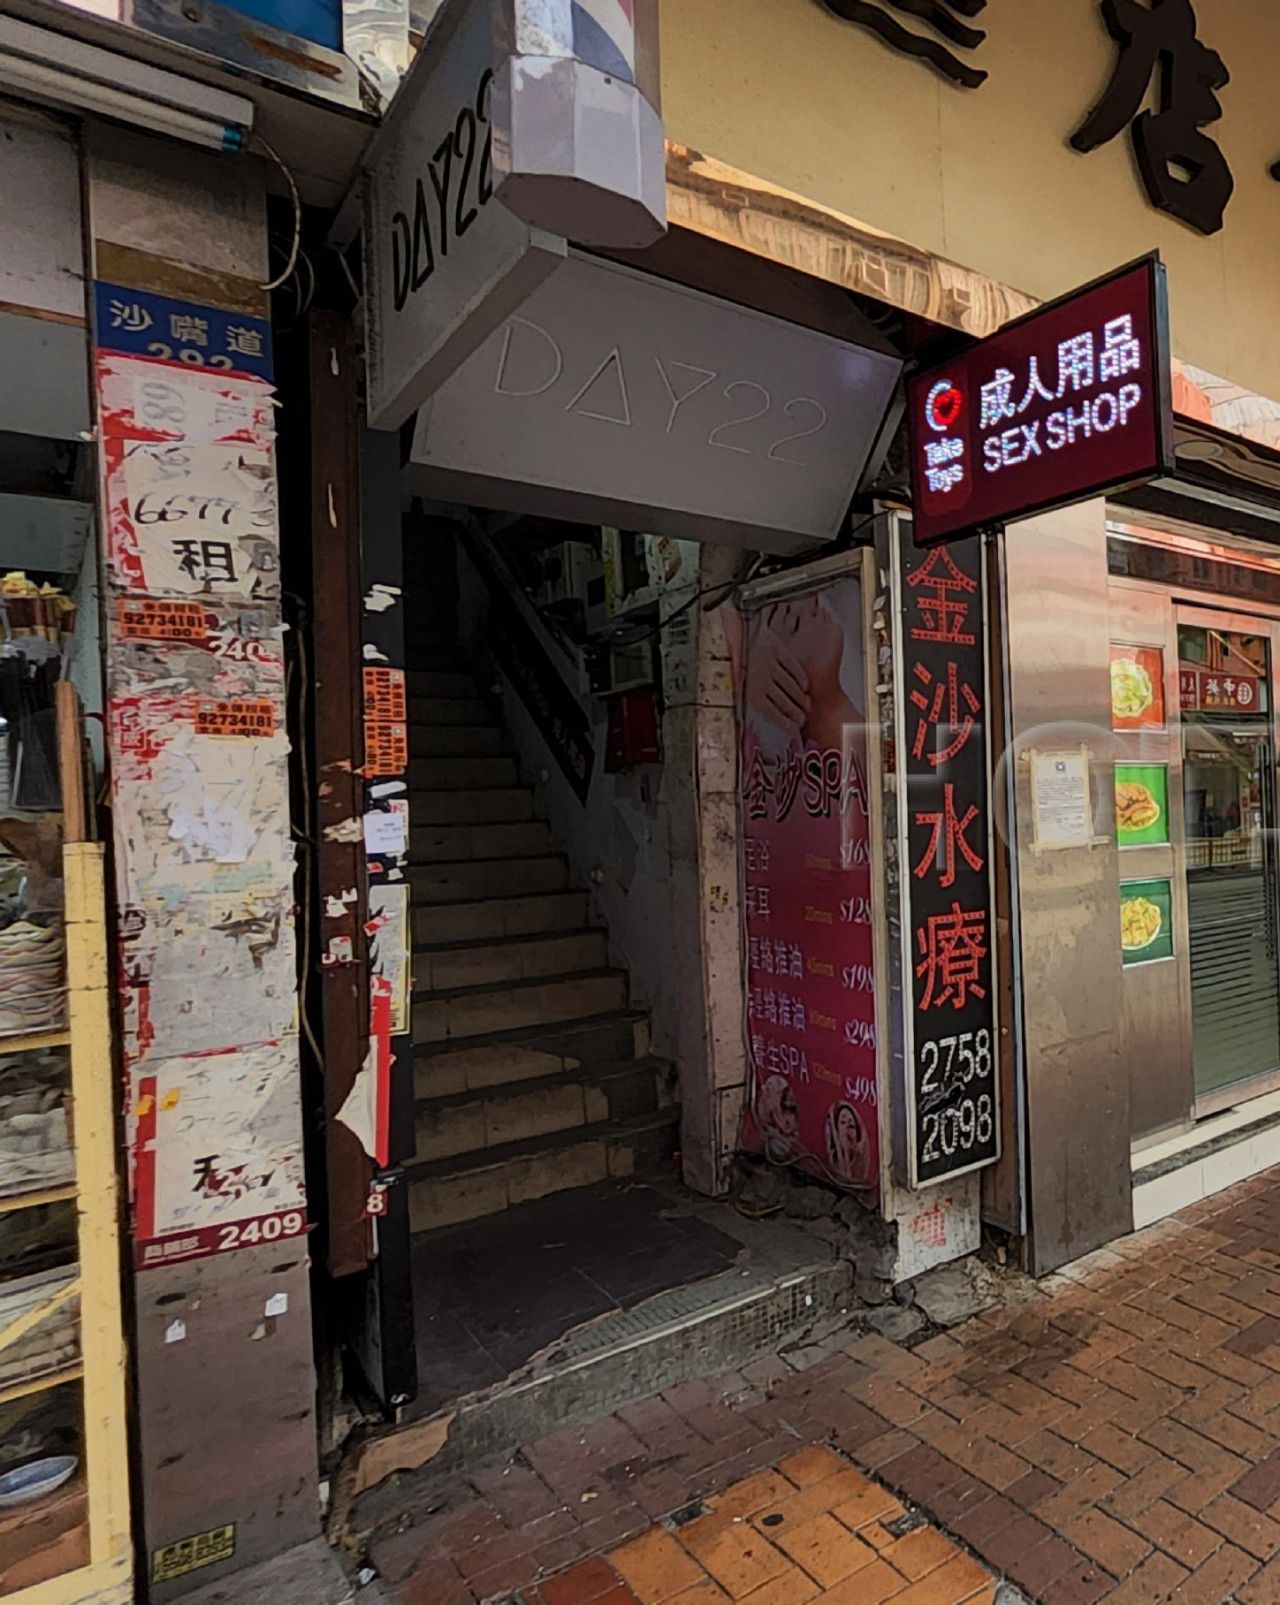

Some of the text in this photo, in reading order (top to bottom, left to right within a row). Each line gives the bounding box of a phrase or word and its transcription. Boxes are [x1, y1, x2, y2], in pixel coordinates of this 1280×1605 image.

[109, 299, 264, 358] 沙嘴道
[494, 315, 827, 467] DAY22
[980, 313, 1140, 430] 成人用品
[983, 382, 1142, 473] SEX SHOP
[172, 539, 239, 583] 租
[906, 546, 988, 1013] 金沙水療
[920, 1027, 992, 1096] 2758
[920, 1093, 993, 1164] 2098
[218, 1212, 303, 1250] 2409
